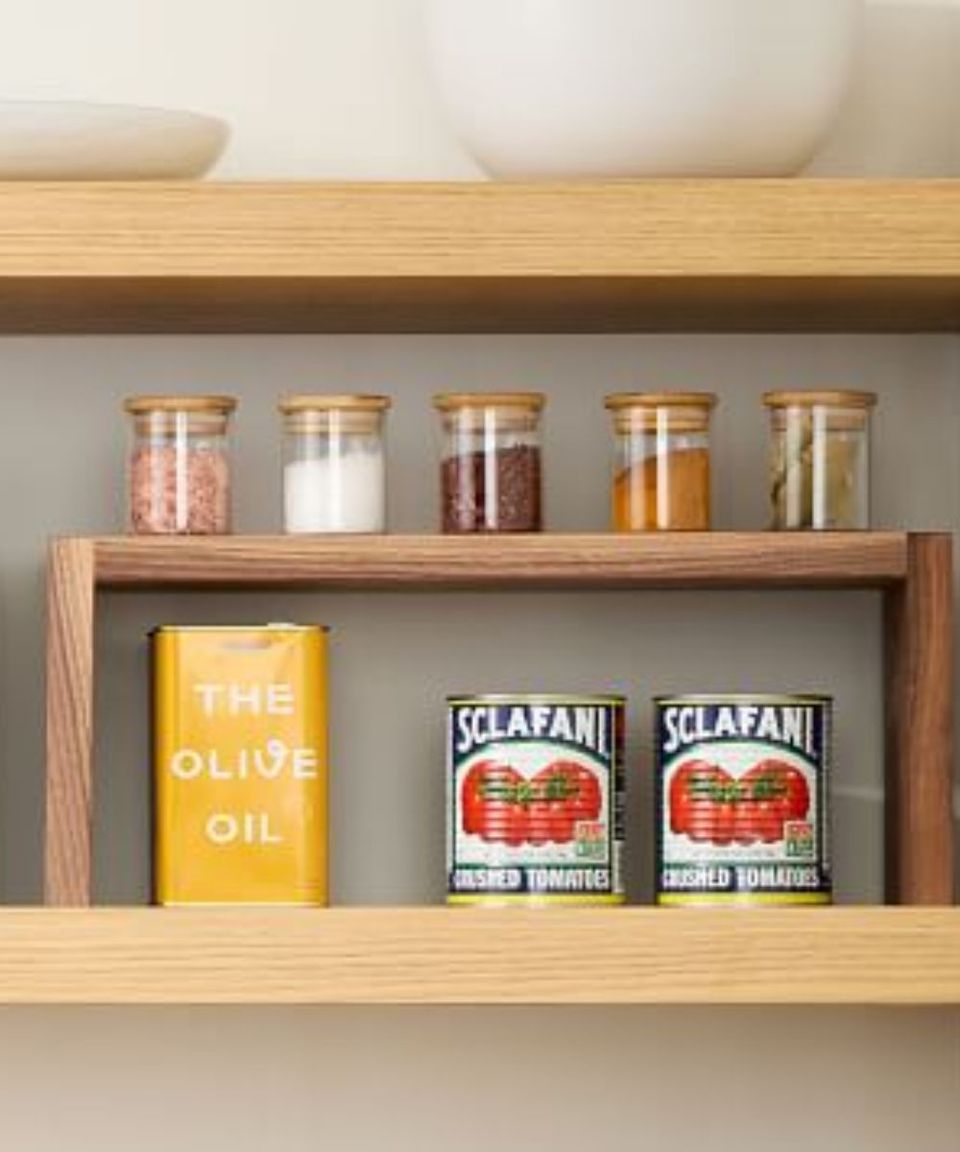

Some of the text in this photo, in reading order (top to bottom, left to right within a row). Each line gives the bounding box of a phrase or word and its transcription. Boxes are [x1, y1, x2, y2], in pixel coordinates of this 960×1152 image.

[193, 683, 295, 717] THE
[456, 706, 608, 753] SCLAFANI
[662, 706, 815, 753] SCLAFANI
[170, 738, 319, 780] OLIVE
[205, 813, 283, 844] OIL
[526, 867, 609, 890] TOMATOES
[662, 867, 818, 888] CRUSHED TOMATOES
